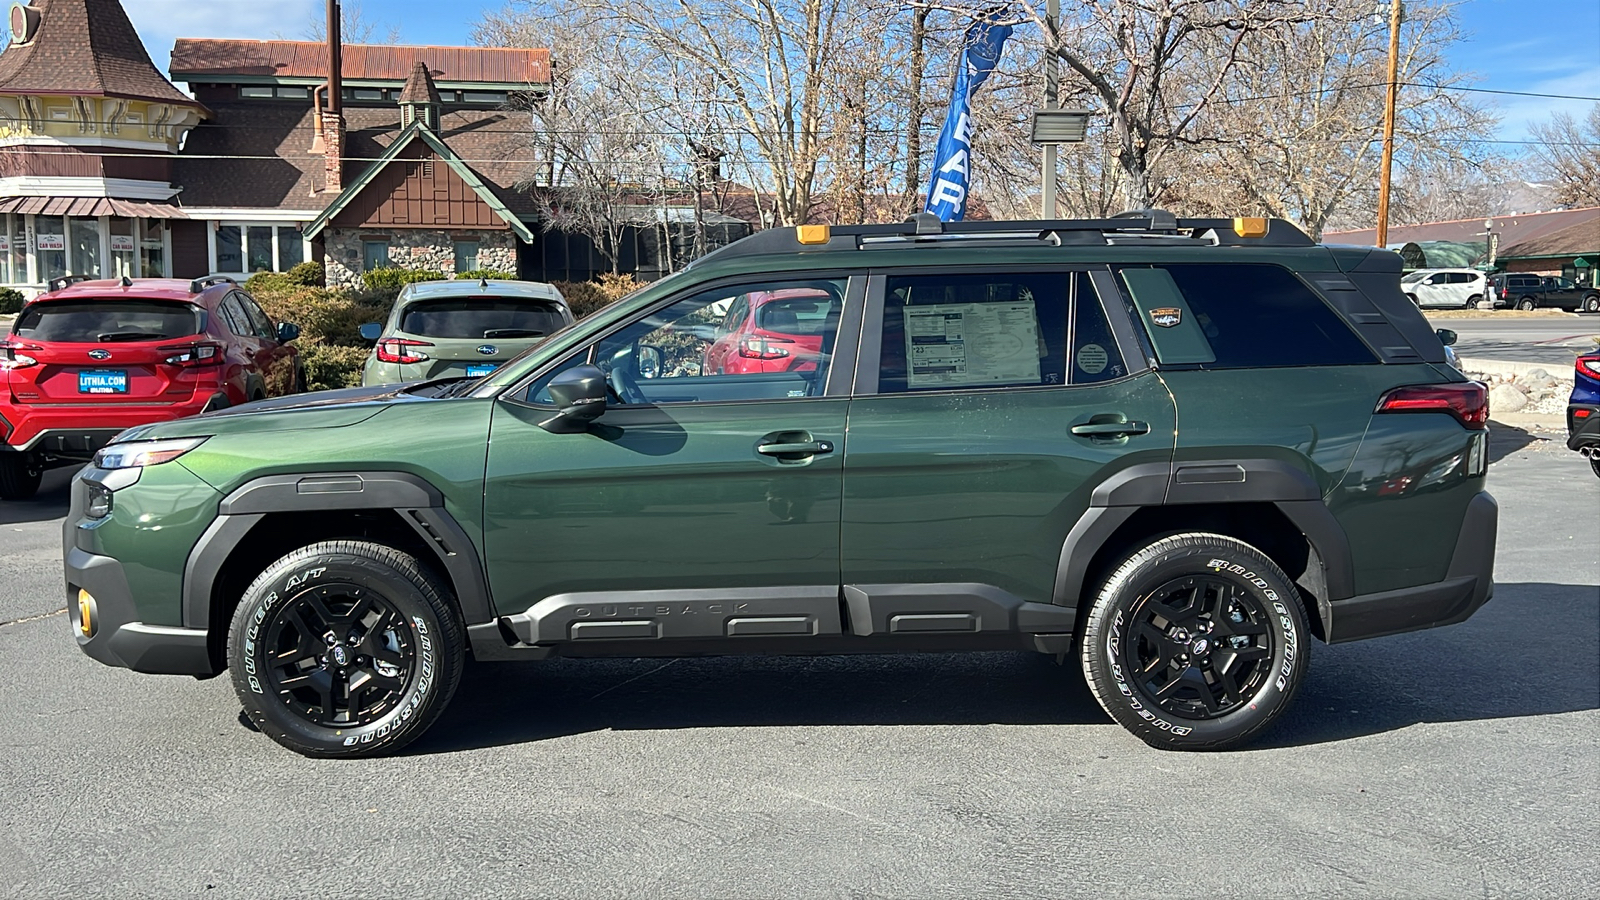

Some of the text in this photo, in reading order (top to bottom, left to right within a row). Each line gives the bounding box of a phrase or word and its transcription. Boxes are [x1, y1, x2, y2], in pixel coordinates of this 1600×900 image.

[80, 376, 126, 386] LITHIA.COM
[244, 567, 327, 695] DUELER A/T
[574, 602, 749, 617] OUTBACK
[1109, 609, 1194, 738] DUELER A/T
[1207, 558, 1297, 693] BRIDGESTONE
[343, 615, 434, 746] BRIDGESTONE
